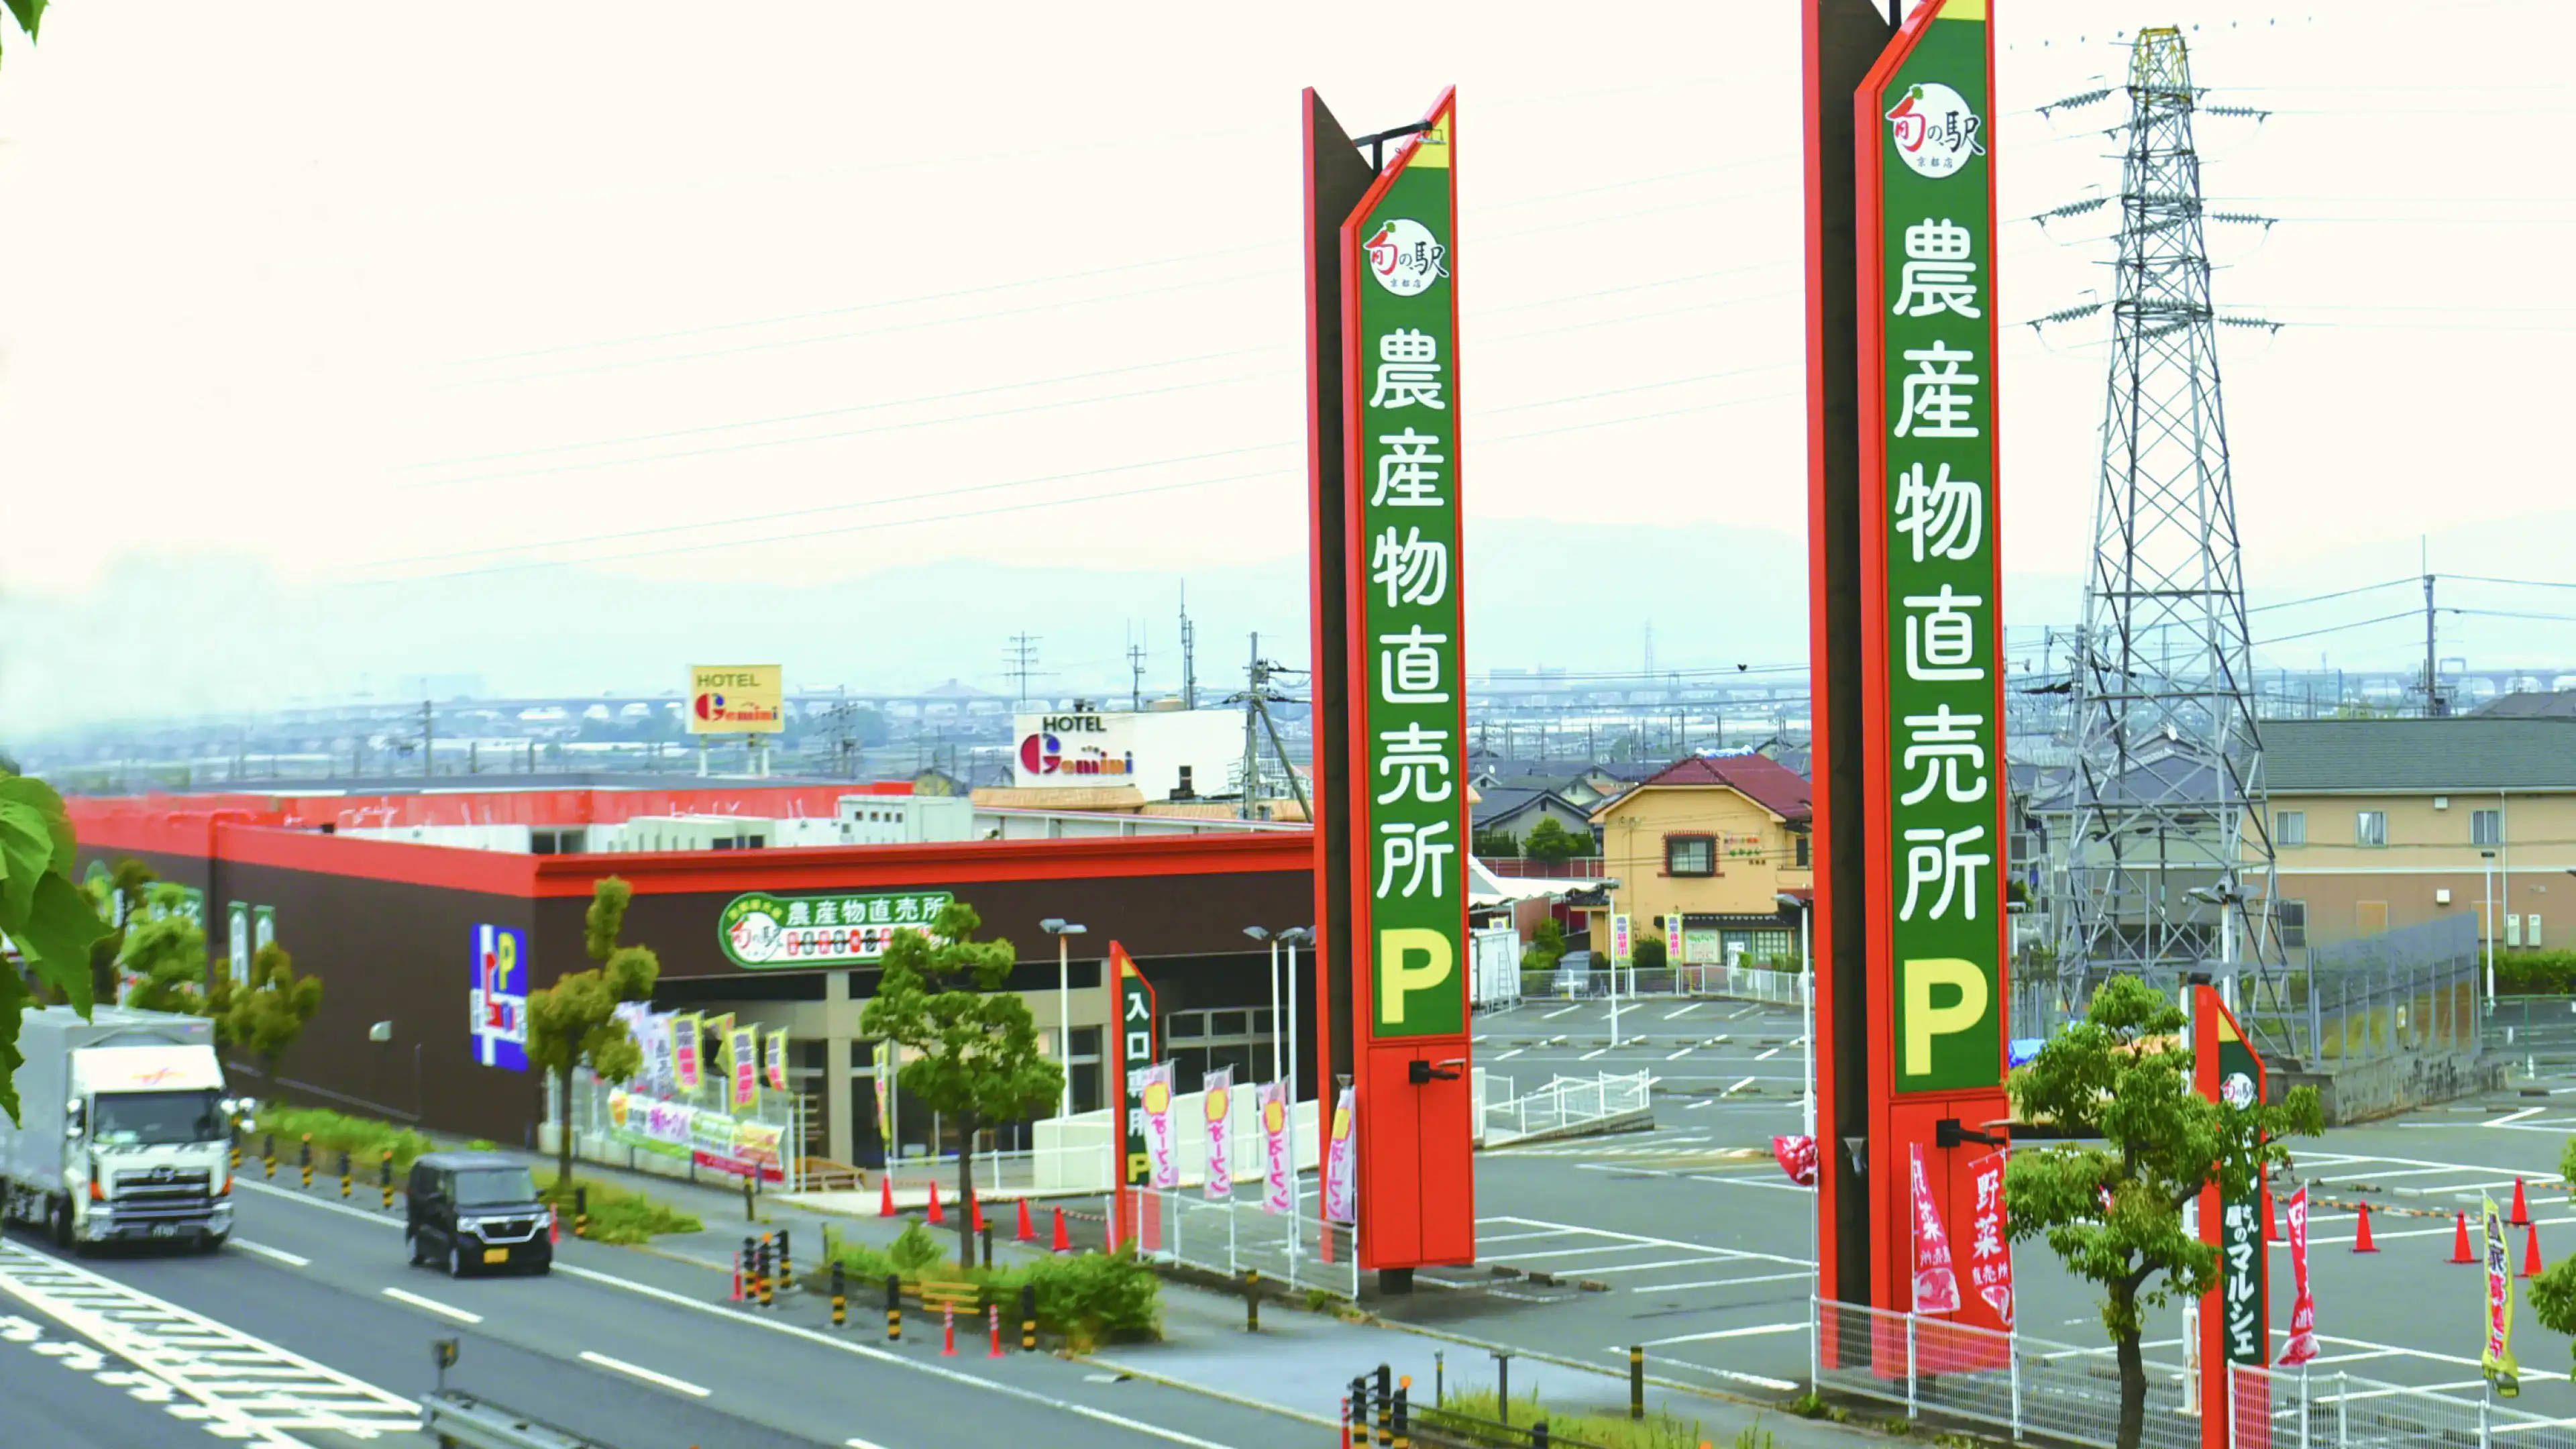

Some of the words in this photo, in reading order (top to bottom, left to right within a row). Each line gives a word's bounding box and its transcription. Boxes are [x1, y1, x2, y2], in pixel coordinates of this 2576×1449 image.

[1887, 95, 1984, 154] 旬の駅
[1917, 156, 1953, 168] 京都店
[1364, 229, 1448, 276] 旬の駅
[1390, 278, 1421, 288] 京都店
[1892, 217, 1990, 922] 農産物直売所
[1368, 328, 1455, 898] 農産物直売所
[697, 674, 760, 688] HOTEL
[695, 693, 777, 721] Gemini
[1042, 716, 1107, 732] HOTEL
[1020, 733, 1133, 775] Gemini
[786, 896, 946, 926] 農産物直売所
[498, 932, 516, 991] P
[1380, 928, 1454, 1024] P
[1903, 957, 1988, 1077] P
[1973, 1168, 2002, 1260] 野菜
